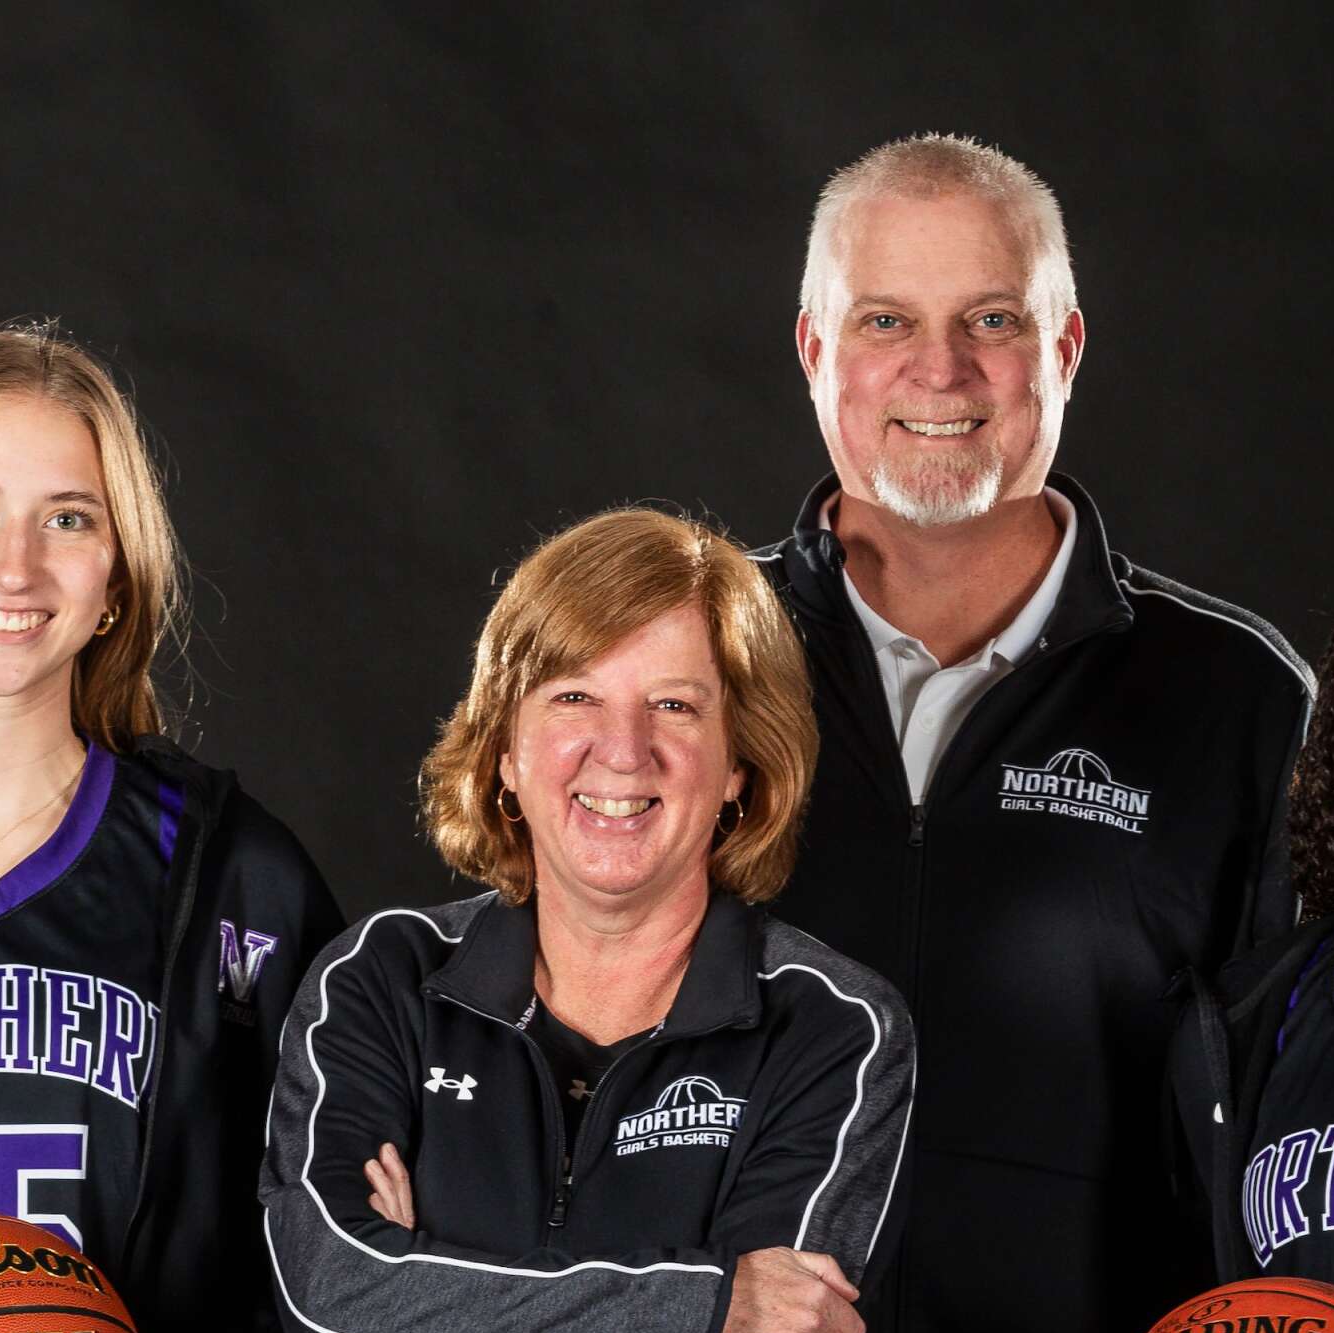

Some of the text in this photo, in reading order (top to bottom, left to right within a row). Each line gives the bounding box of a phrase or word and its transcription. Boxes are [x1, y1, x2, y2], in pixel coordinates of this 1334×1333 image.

[1002, 769, 1150, 815] NORTHERN
[1000, 798, 1143, 834] GIRLS BASKETBALL
[218, 918, 279, 1000] N
[617, 1103, 747, 1140] NORTHER
[616, 1132, 729, 1156] GIRLS BASKETB
